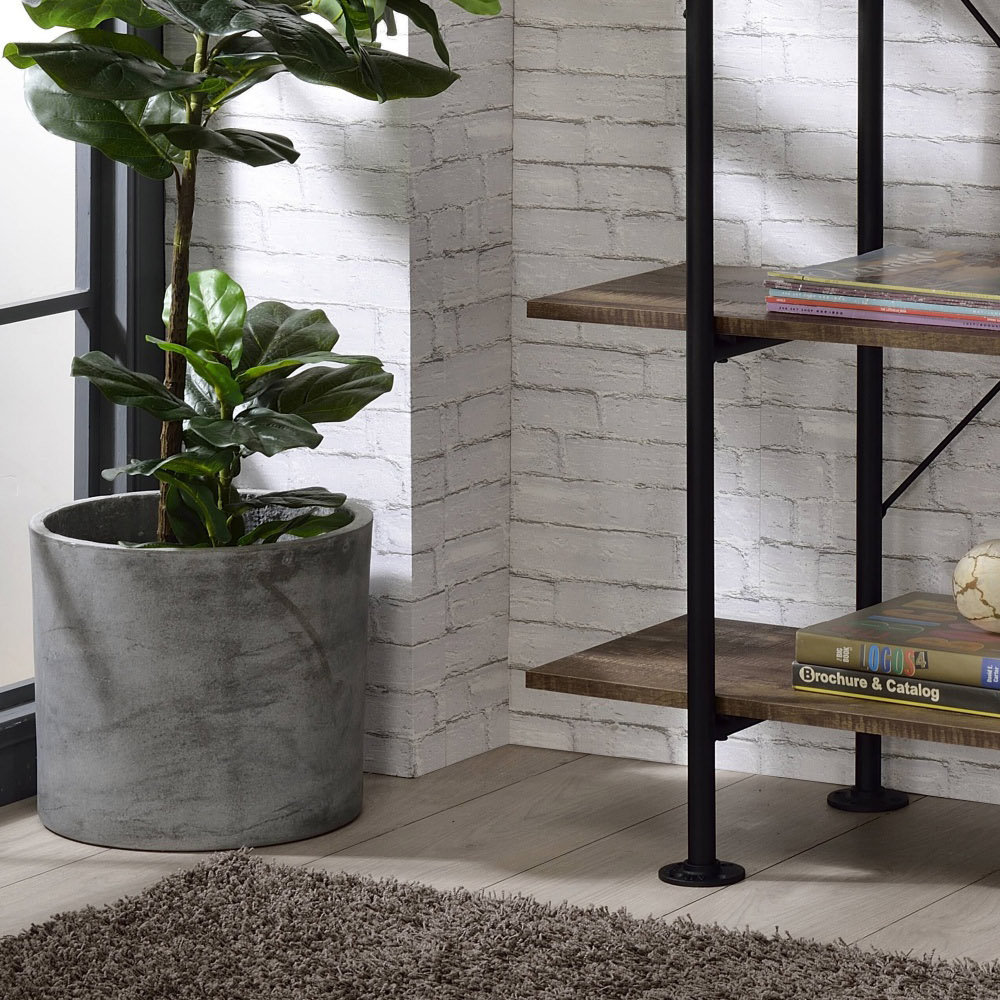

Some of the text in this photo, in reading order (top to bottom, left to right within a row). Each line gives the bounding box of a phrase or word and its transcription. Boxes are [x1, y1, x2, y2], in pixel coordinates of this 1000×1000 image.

[798, 665, 940, 702] Brochure & Catalog
